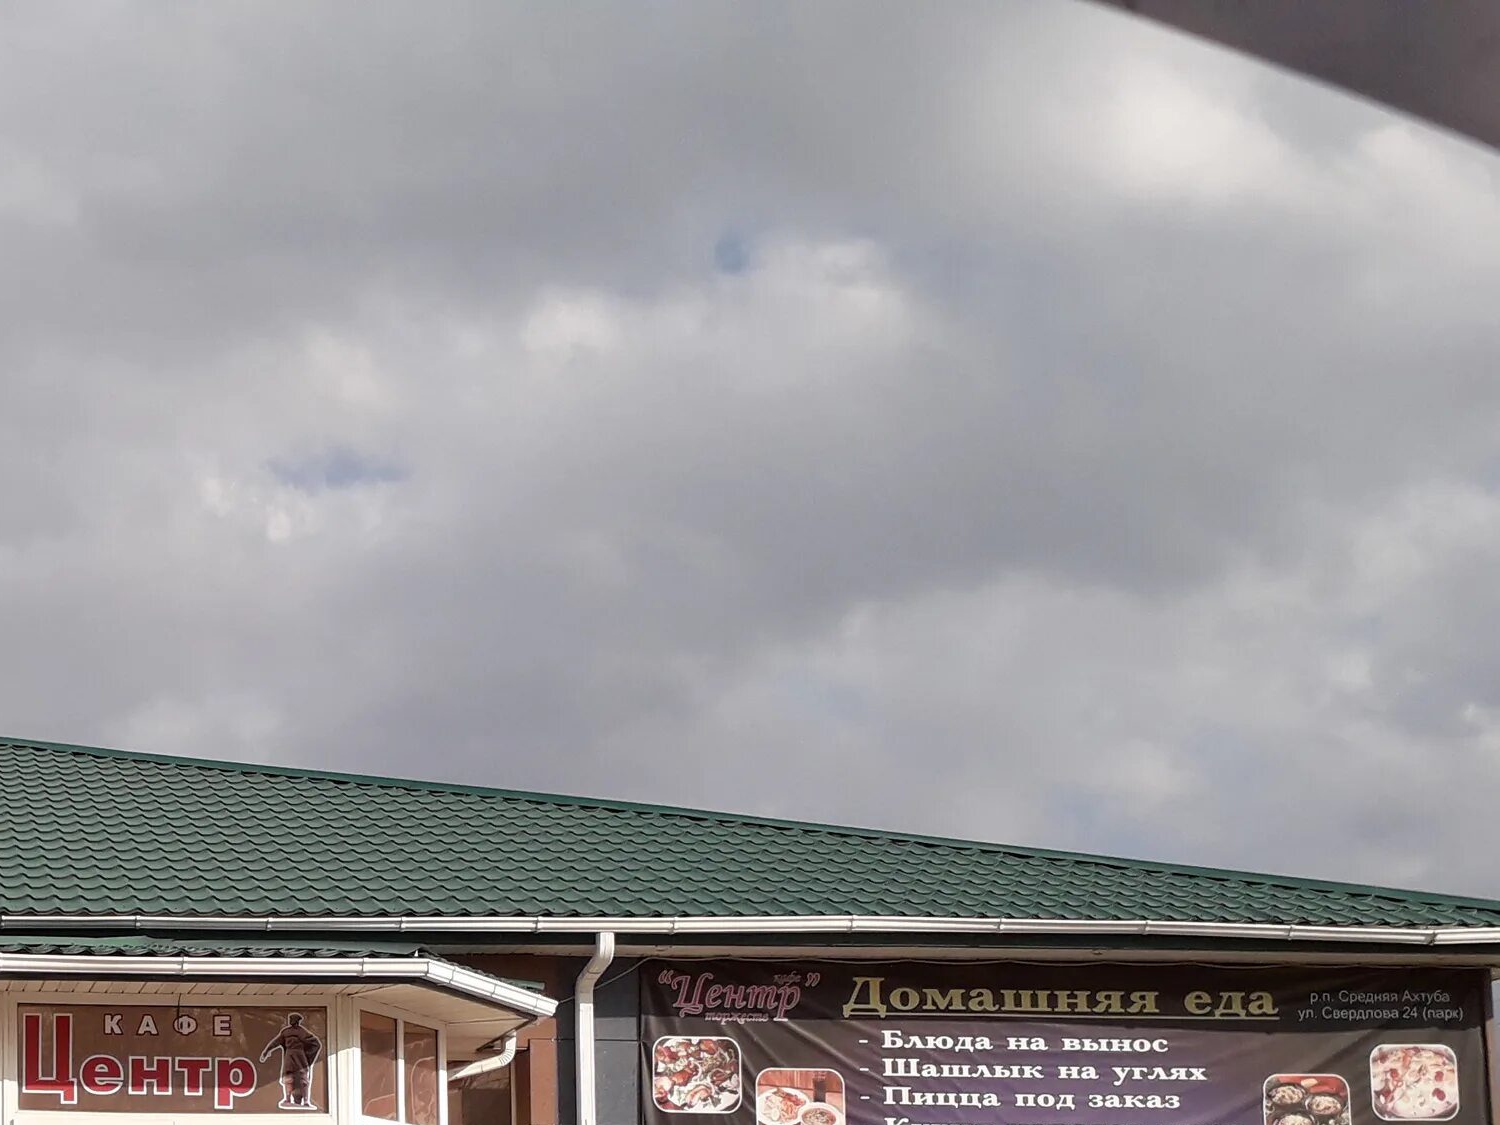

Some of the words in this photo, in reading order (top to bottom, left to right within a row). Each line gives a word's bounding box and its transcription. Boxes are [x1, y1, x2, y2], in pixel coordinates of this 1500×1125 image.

[842, 976, 1160, 1019] Домашняя
[1183, 990, 1280, 1019] еда
[1309, 991, 1334, 1005] р.п.
[1338, 990, 1398, 1005] Средняя
[1401, 989, 1451, 1006] Ахтуба
[102, 1013, 233, 1037] КАФЕ
[1297, 1008, 1318, 1022] ул.
[1321, 1006, 1399, 1022] Свердлова
[1401, 1007, 1419, 1019] 24
[1421, 1007, 1464, 1022] (парк)
[880, 1029, 994, 1053] Блюда
[1006, 1036, 1049, 1051] на
[1060, 1037, 1169, 1053] вынос
[20, 1012, 257, 1110] Центр
[881, 1057, 1045, 1079] Шашлык
[1057, 1065, 1100, 1080] на
[1111, 1066, 1208, 1087] углях
[882, 1086, 1002, 1109] Пицца
[1014, 1092, 1076, 1111] под
[1088, 1094, 1181, 1109] заказ
